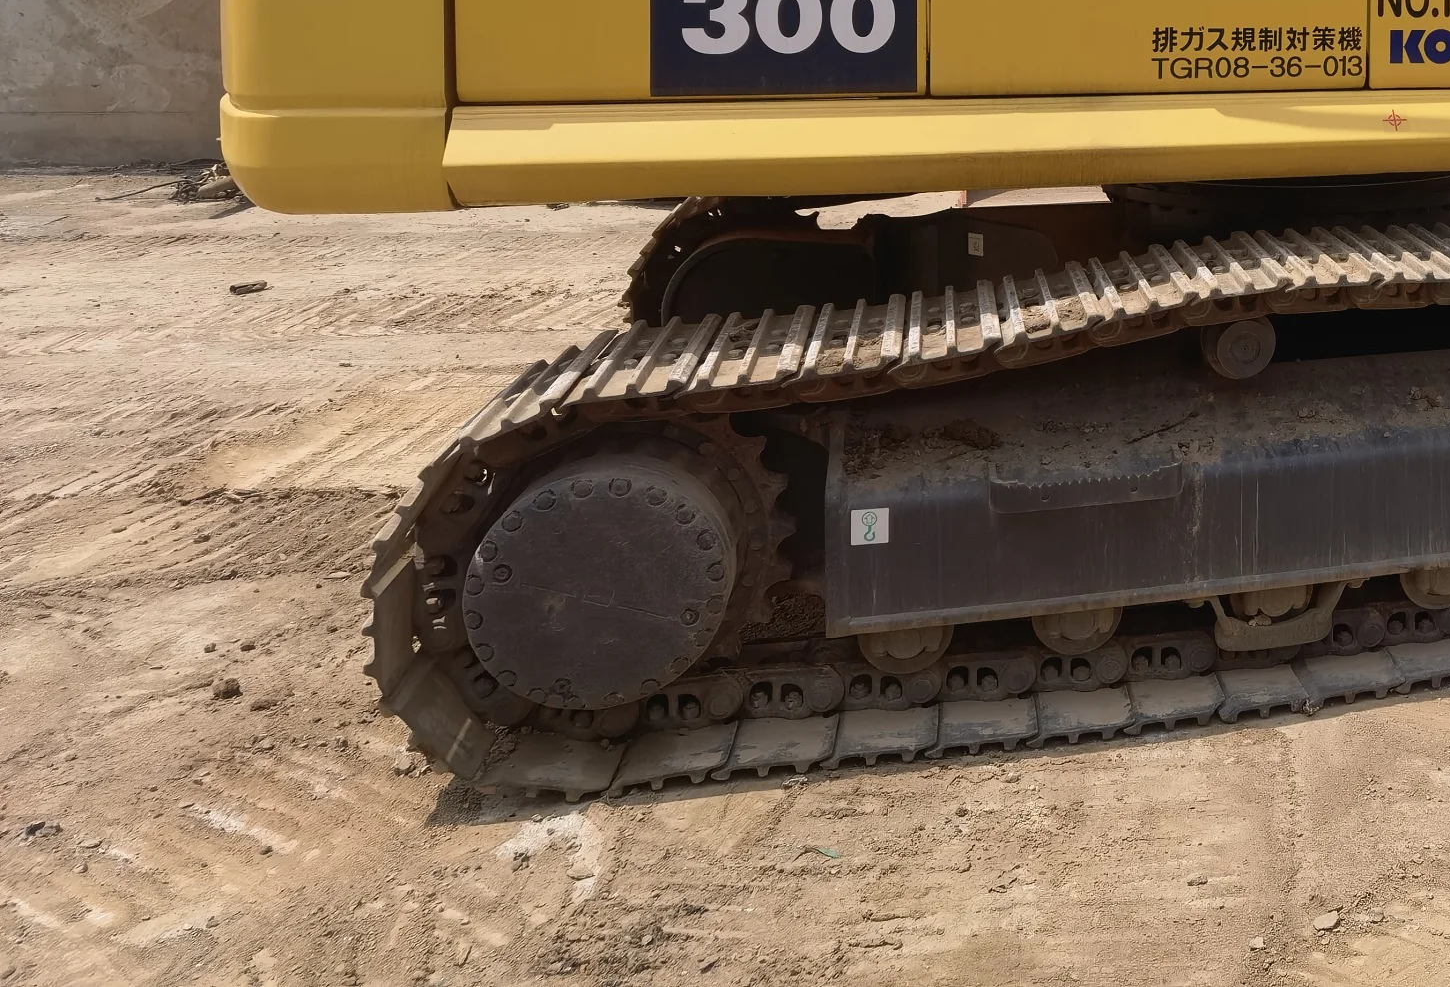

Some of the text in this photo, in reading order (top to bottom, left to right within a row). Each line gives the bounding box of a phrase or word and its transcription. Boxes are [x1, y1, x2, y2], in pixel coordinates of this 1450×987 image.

[1151, 26, 1363, 53] 排ガス規制対策機
[1151, 55, 1363, 80] TGR08-36-013
